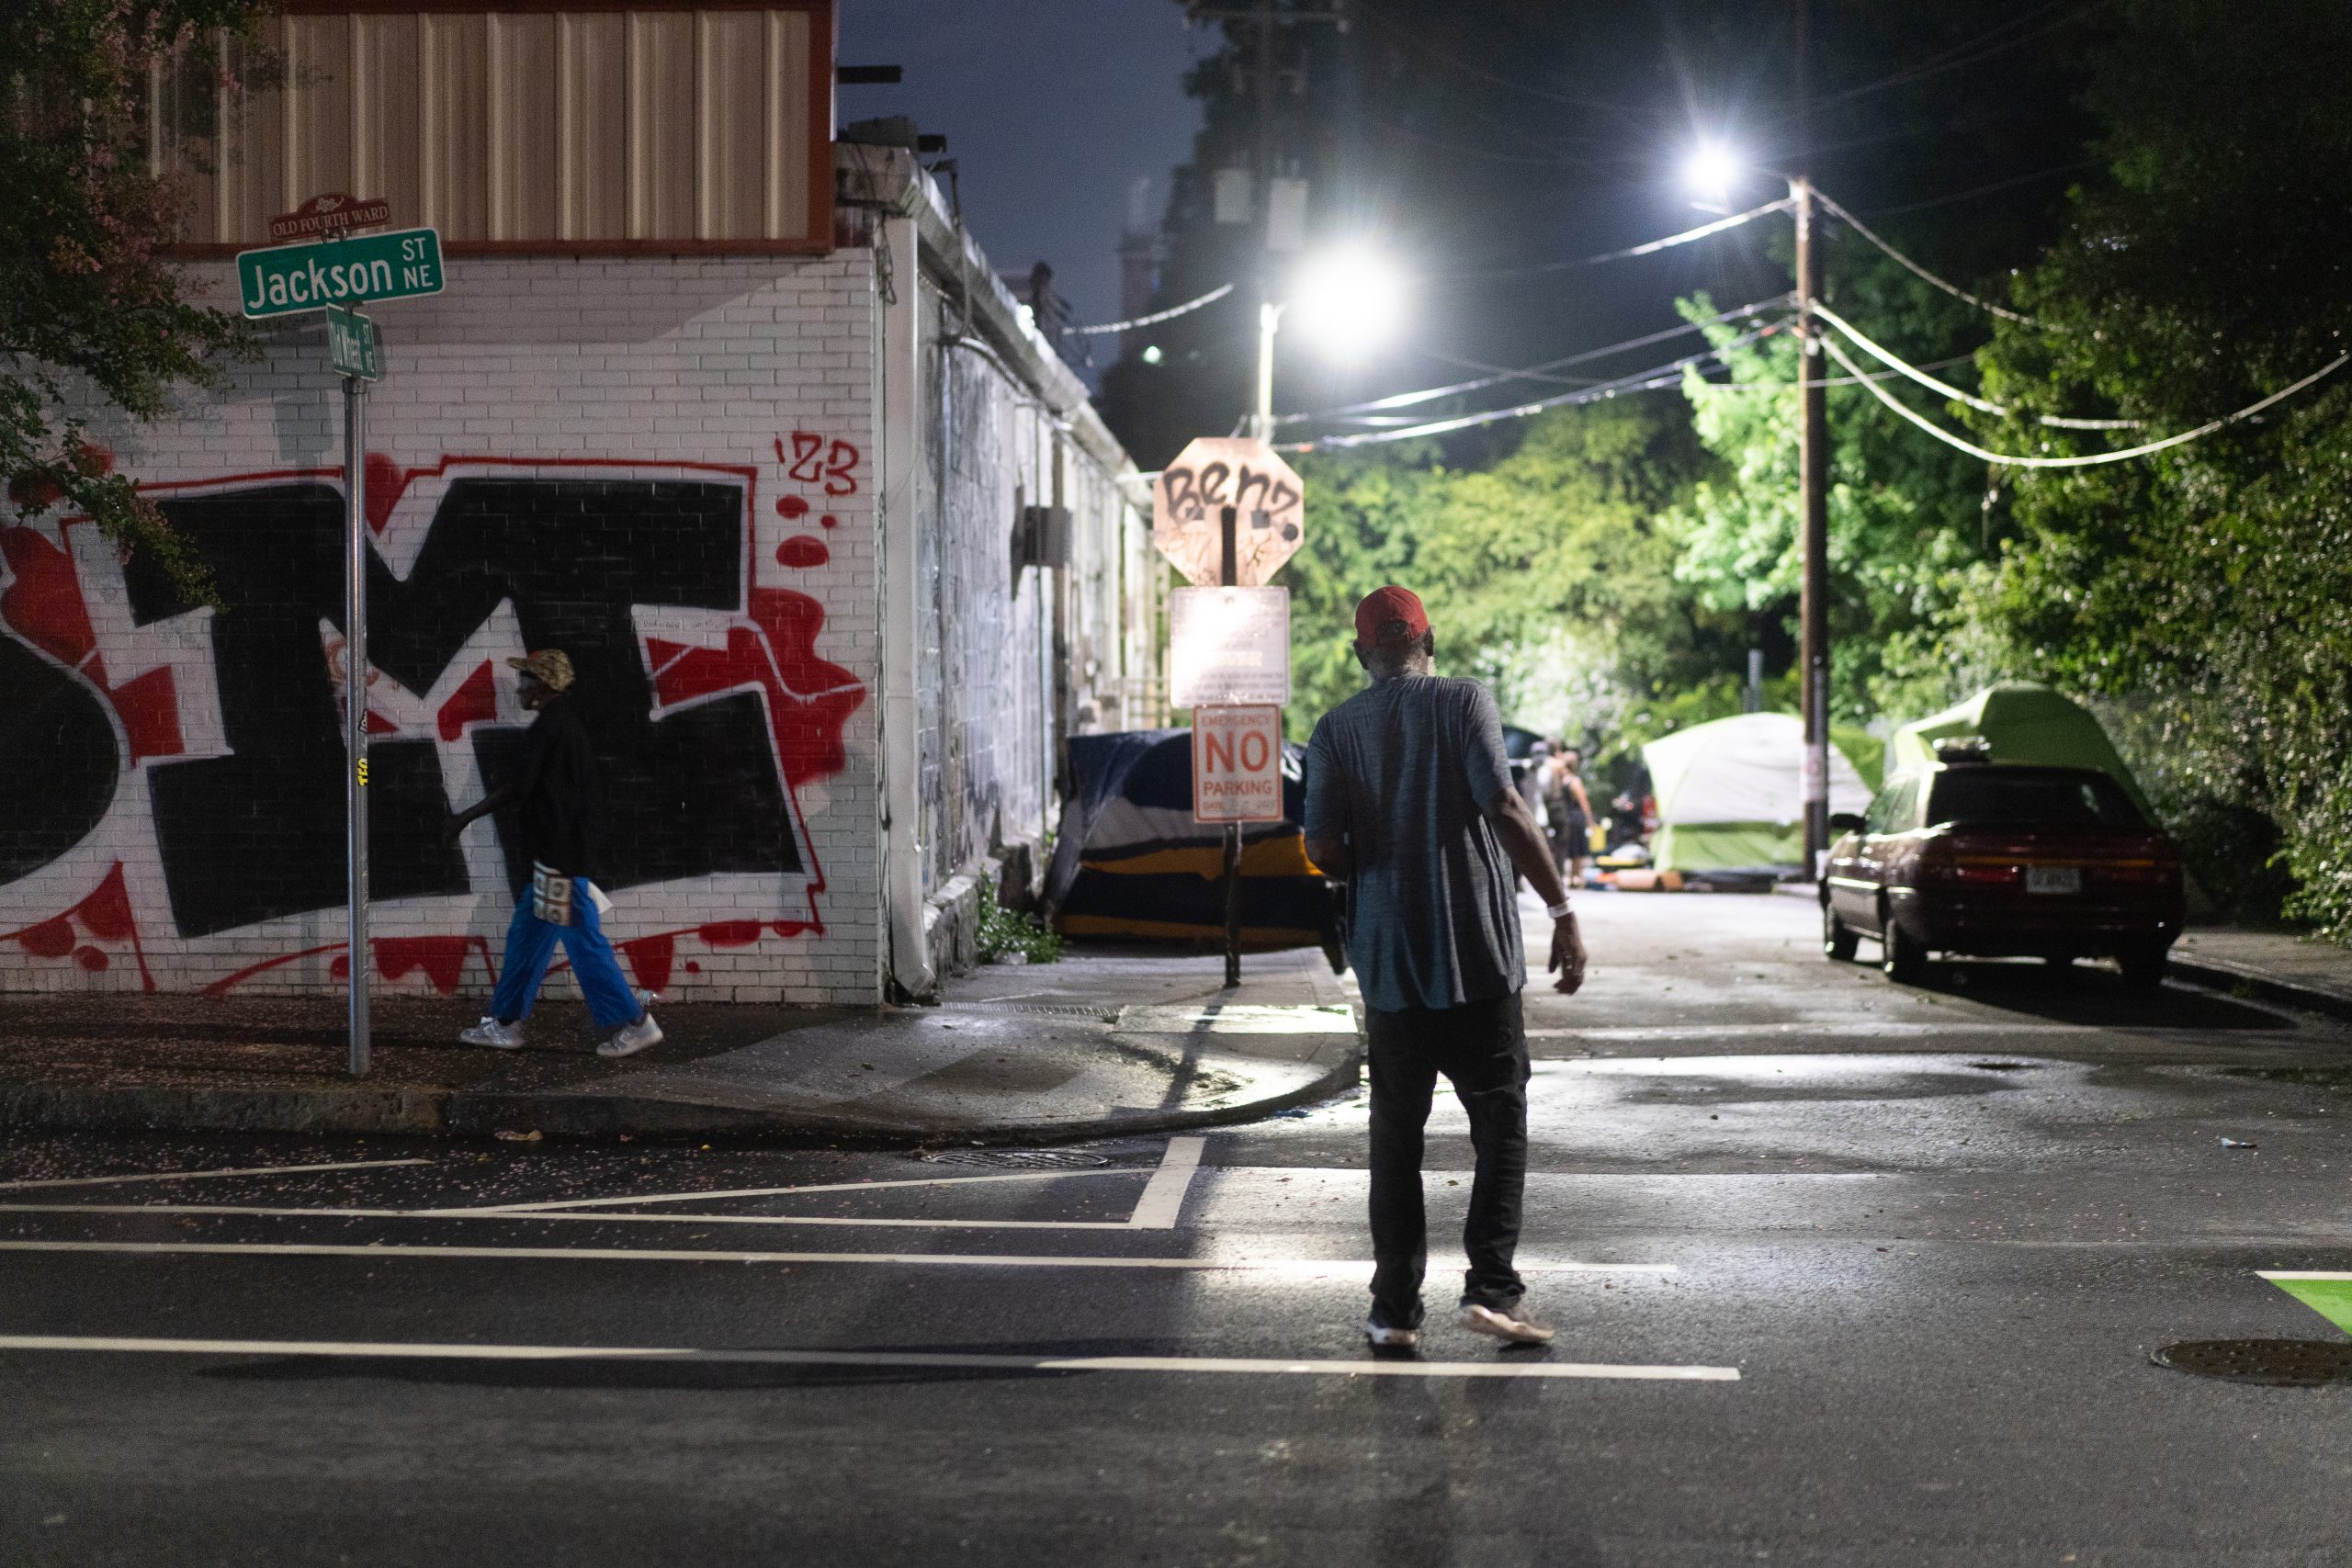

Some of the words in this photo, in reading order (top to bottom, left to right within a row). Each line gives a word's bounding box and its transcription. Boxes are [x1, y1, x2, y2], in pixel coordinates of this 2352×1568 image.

[273, 220, 298, 236] OLD
[300, 211, 349, 232] FOURTH
[351, 205, 388, 222] WARD
[248, 257, 393, 310] Jackson
[401, 237, 426, 262] ST
[403, 265, 434, 289] NE
[1204, 730, 1270, 773] NO
[1203, 780, 1273, 796] PARKING
